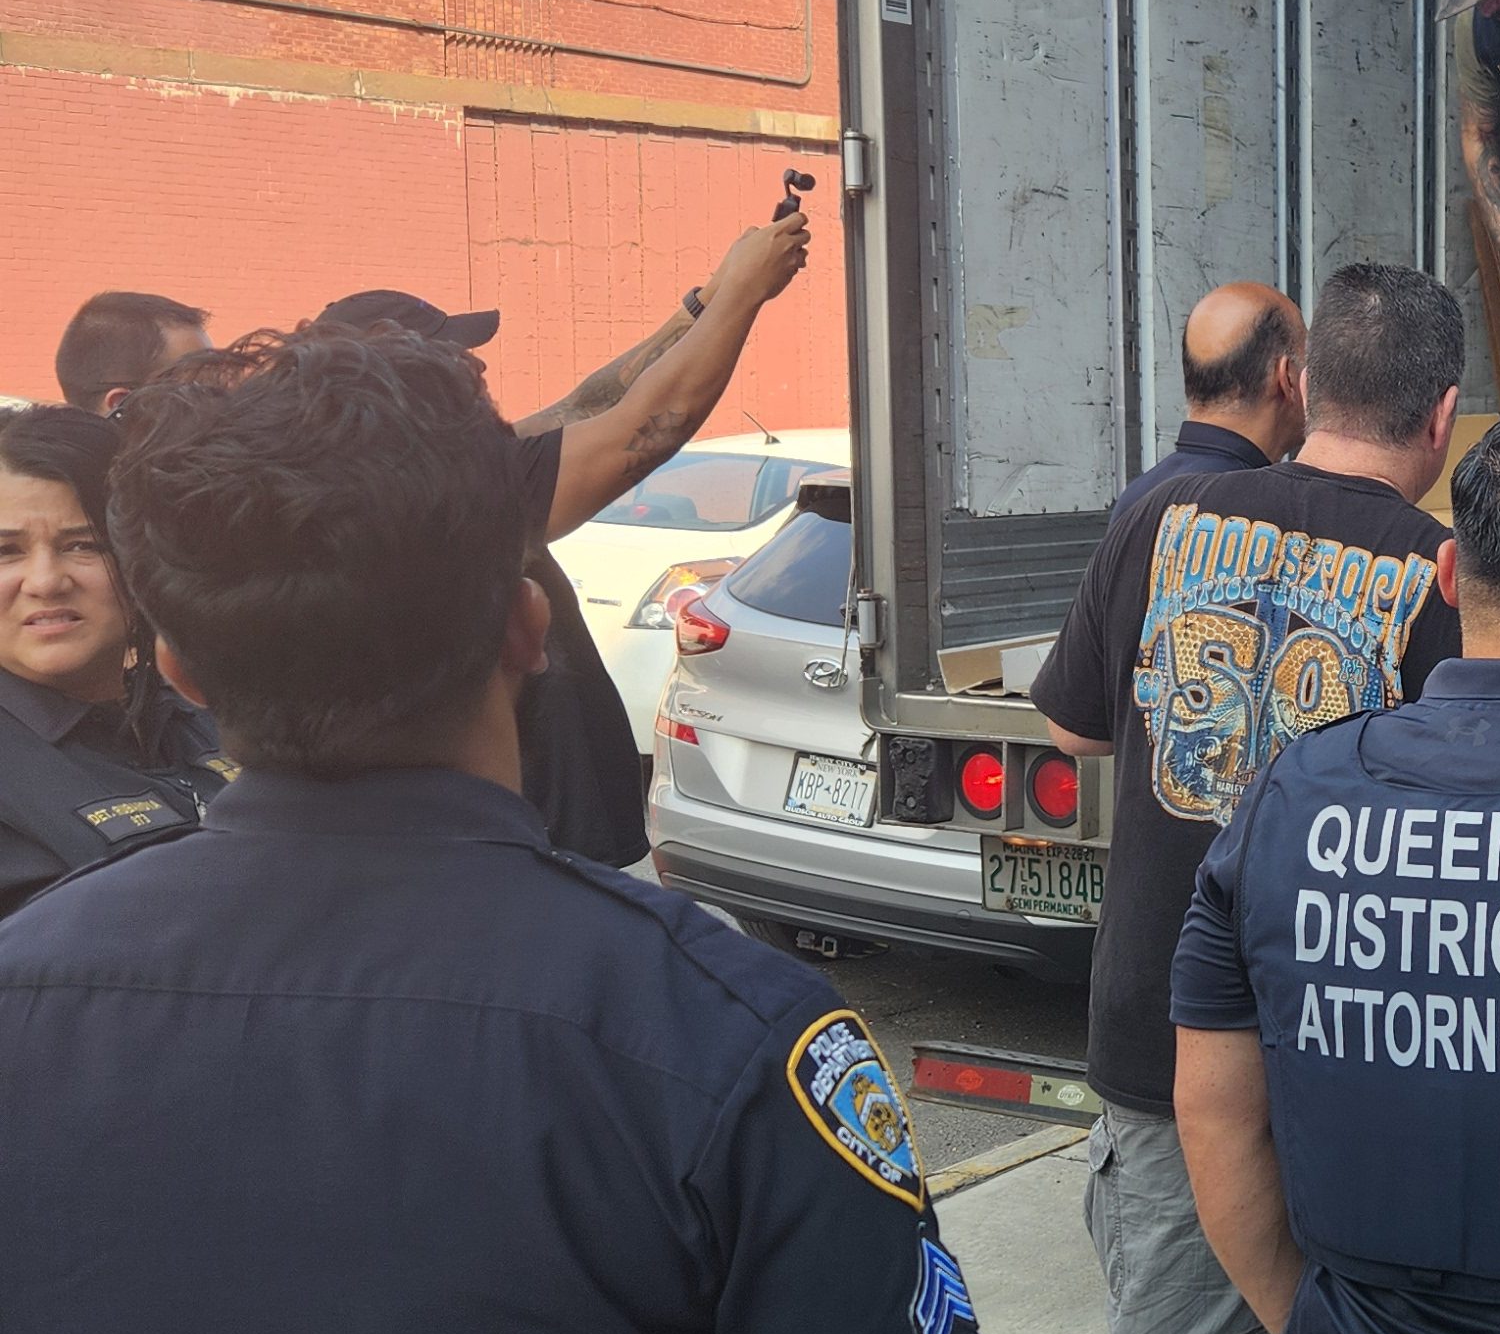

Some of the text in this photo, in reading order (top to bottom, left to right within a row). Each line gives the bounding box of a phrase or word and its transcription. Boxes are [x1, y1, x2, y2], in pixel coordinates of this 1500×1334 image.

[1139, 503, 1437, 700] WOODSTOCK
[816, 762, 858, 778] NEW YORK
[785, 805, 817, 817] HUDSON
[817, 812, 838, 822] AUTO
[838, 817, 865, 827] GROUP
[831, 778, 868, 811] 8217
[807, 1022, 855, 1068] POLICE
[810, 1039, 877, 1107] DEPARTMEN
[836, 1126, 903, 1184] CITY OF
